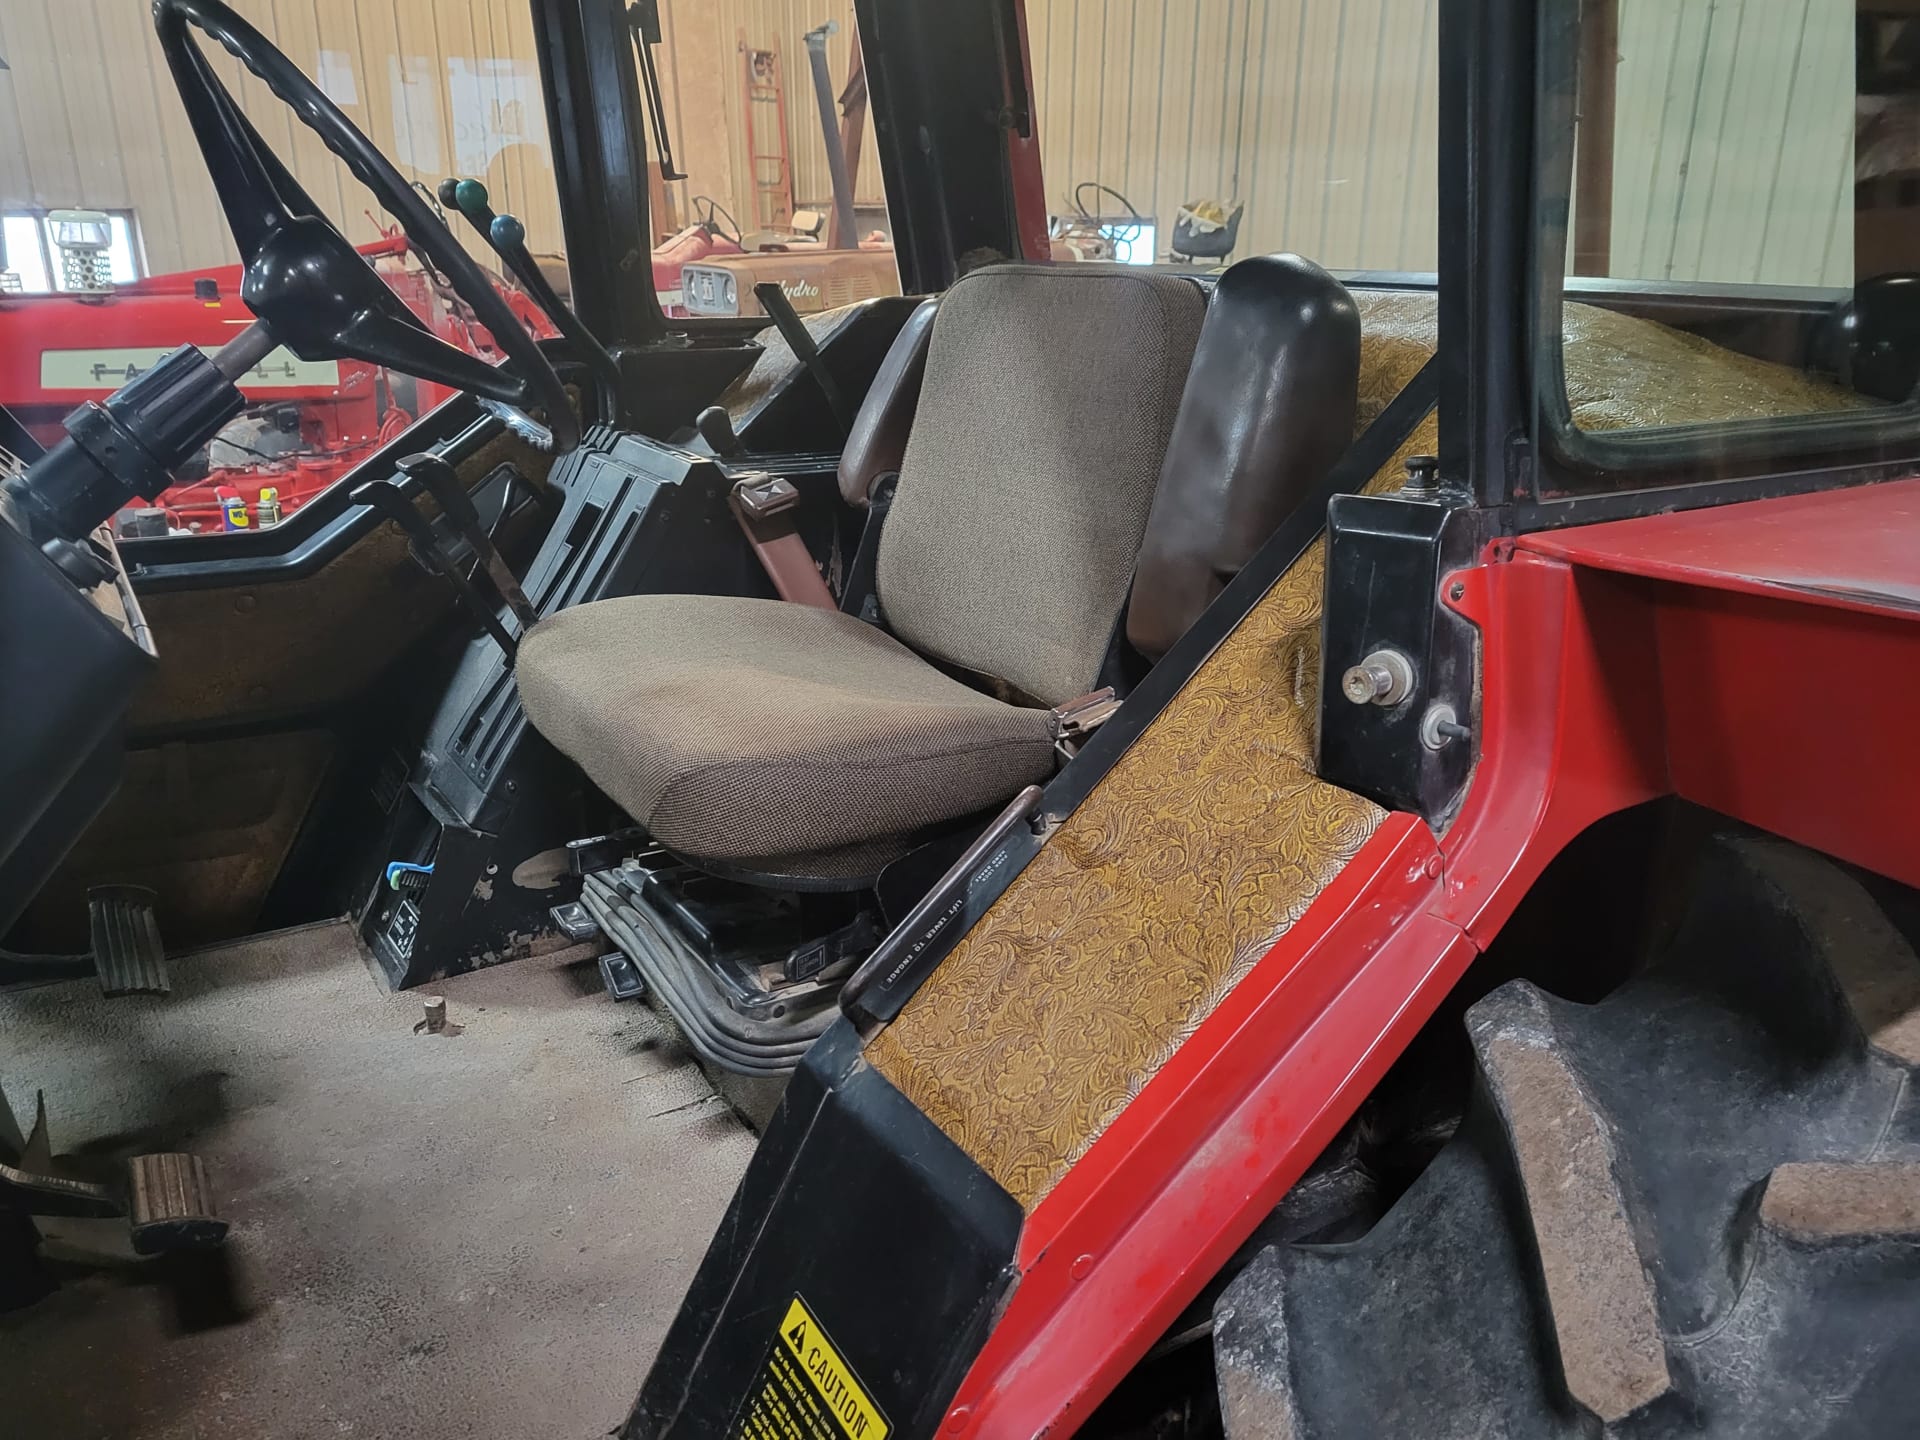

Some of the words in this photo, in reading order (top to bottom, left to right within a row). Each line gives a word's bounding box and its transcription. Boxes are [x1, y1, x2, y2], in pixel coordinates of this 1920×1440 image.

[948, 899, 963, 915] LIFT
[925, 916, 948, 940] LEVER
[914, 941, 926, 952] TO
[886, 953, 914, 984] ENGAGE
[807, 1347, 868, 1439] CAUTION
